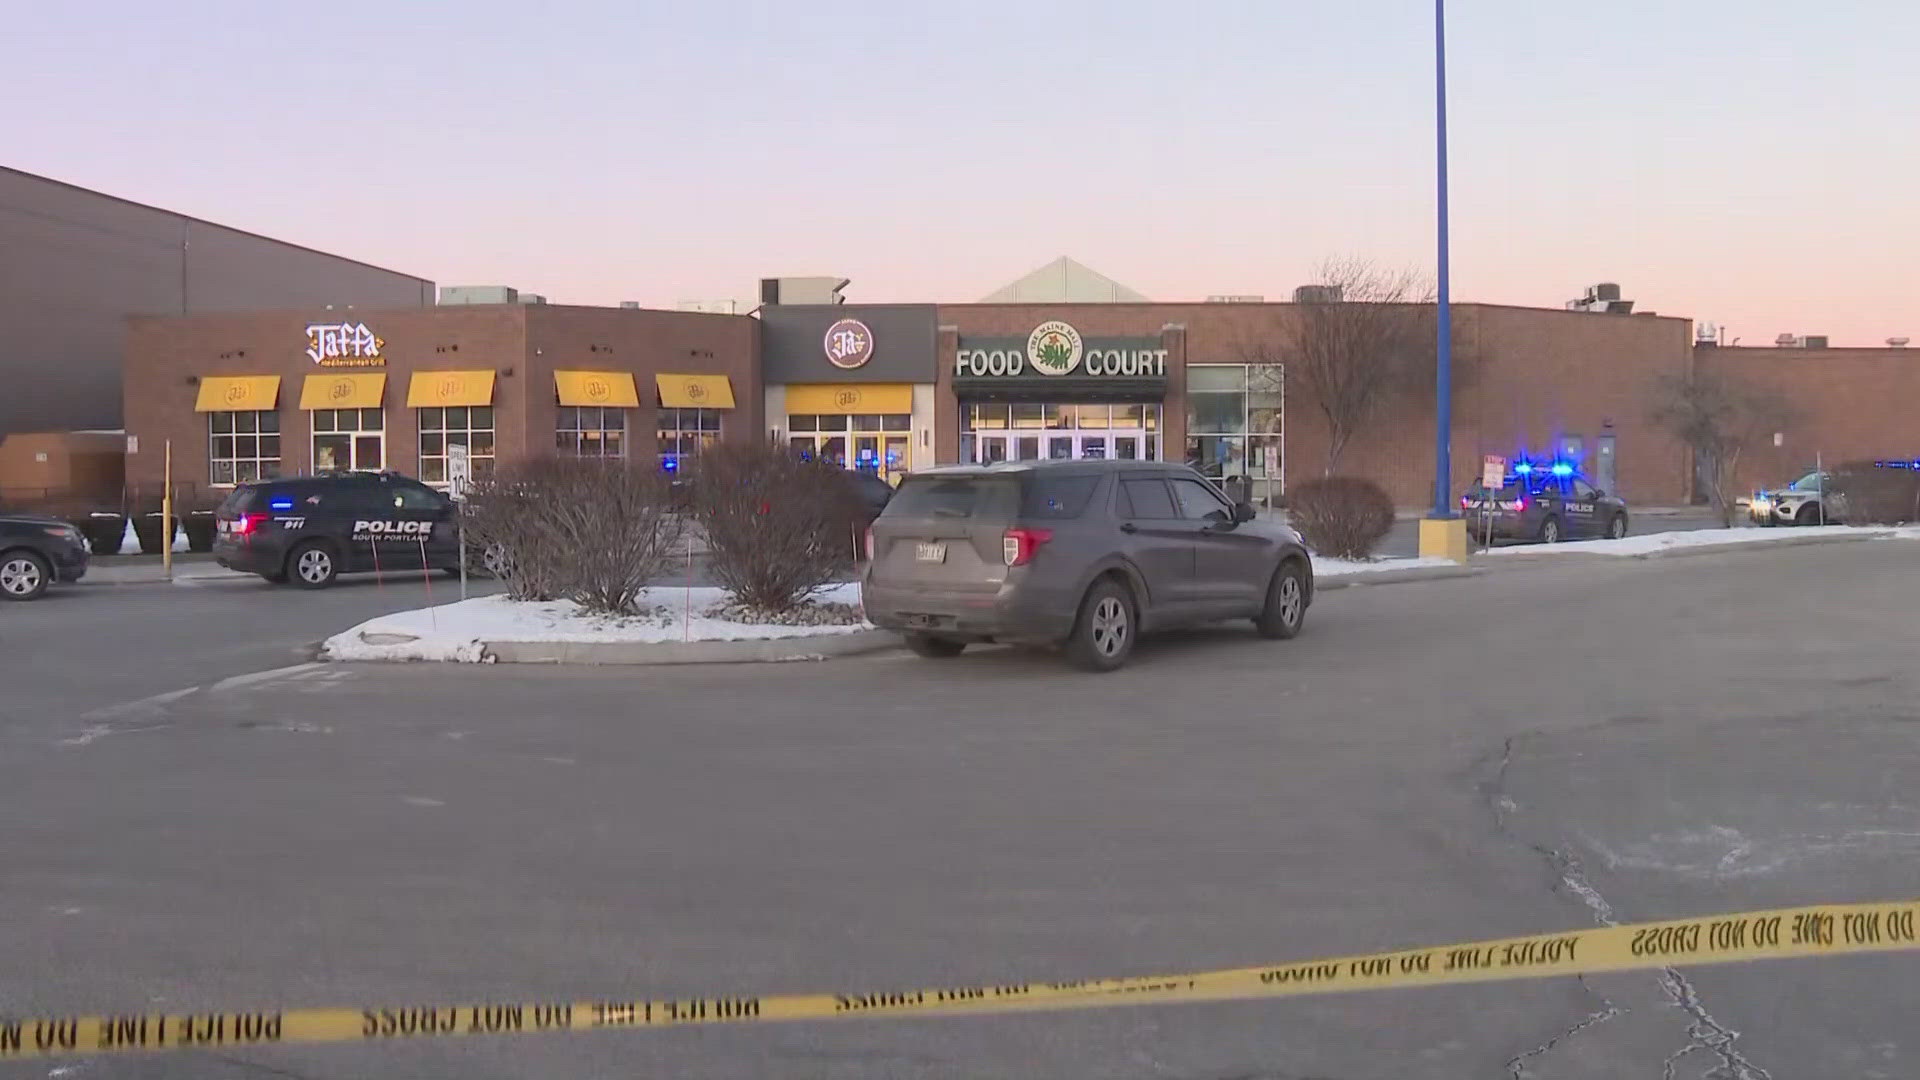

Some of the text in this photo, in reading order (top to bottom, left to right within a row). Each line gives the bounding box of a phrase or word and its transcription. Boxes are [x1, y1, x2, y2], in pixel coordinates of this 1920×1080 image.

[306, 322, 380, 364] Jaffa
[1031, 323, 1080, 350] THE MAINE MALL
[956, 350, 1168, 376] FOOD COURT
[453, 475, 465, 495] 10
[1565, 502, 1594, 512] POLICE
[284, 520, 304, 529] 911
[353, 520, 433, 533] POLICE
[362, 1006, 457, 1038] CROSS
[468, 1005, 523, 1034] NOT
[35, 1018, 77, 1051] DO
